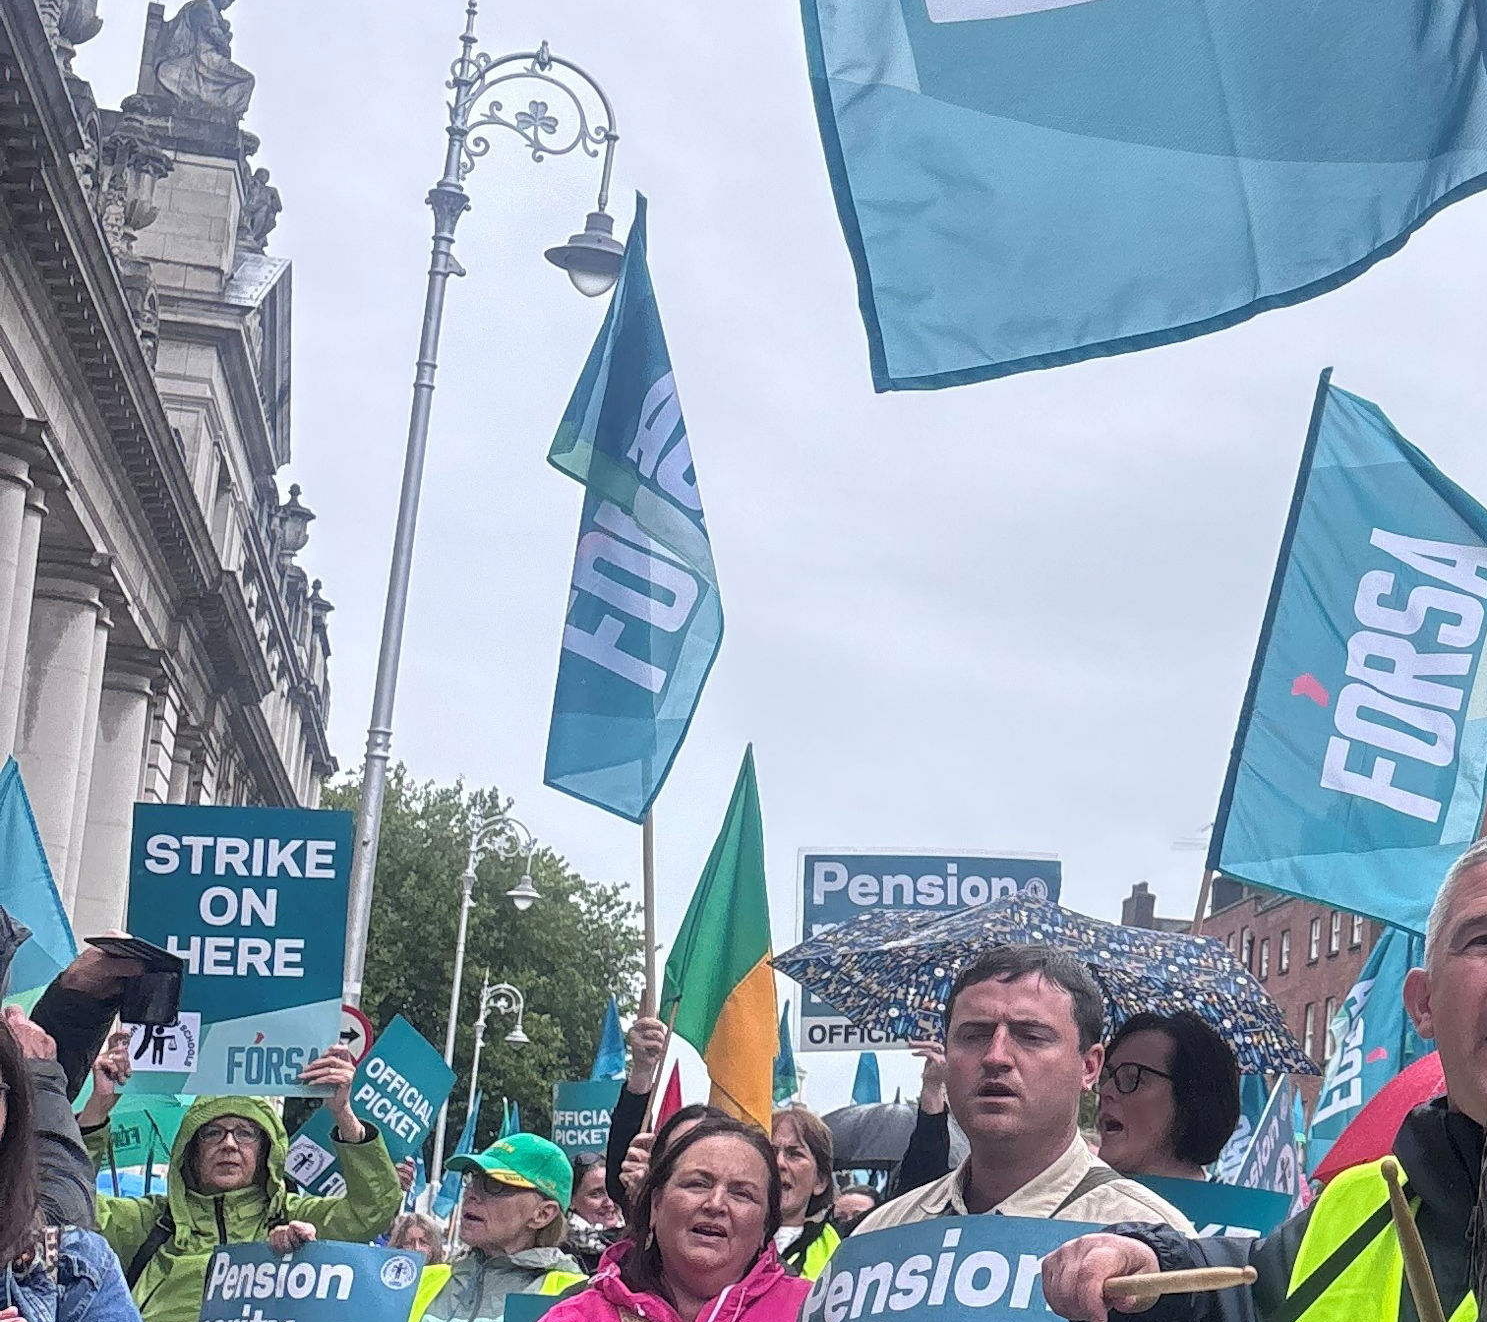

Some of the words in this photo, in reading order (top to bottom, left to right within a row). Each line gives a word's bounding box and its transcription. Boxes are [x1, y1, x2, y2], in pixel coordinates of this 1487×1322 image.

[145, 834, 336, 878] STRIKE
[199, 886, 277, 927] ON
[812, 862, 1018, 907] Pension
[167, 935, 305, 977] HERE
[353, 1083, 421, 1144] PICKET
[365, 1057, 433, 1128] OFFICIAL
[553, 1109, 613, 1126] OFFICIA
[207, 1252, 354, 1300] Pension
